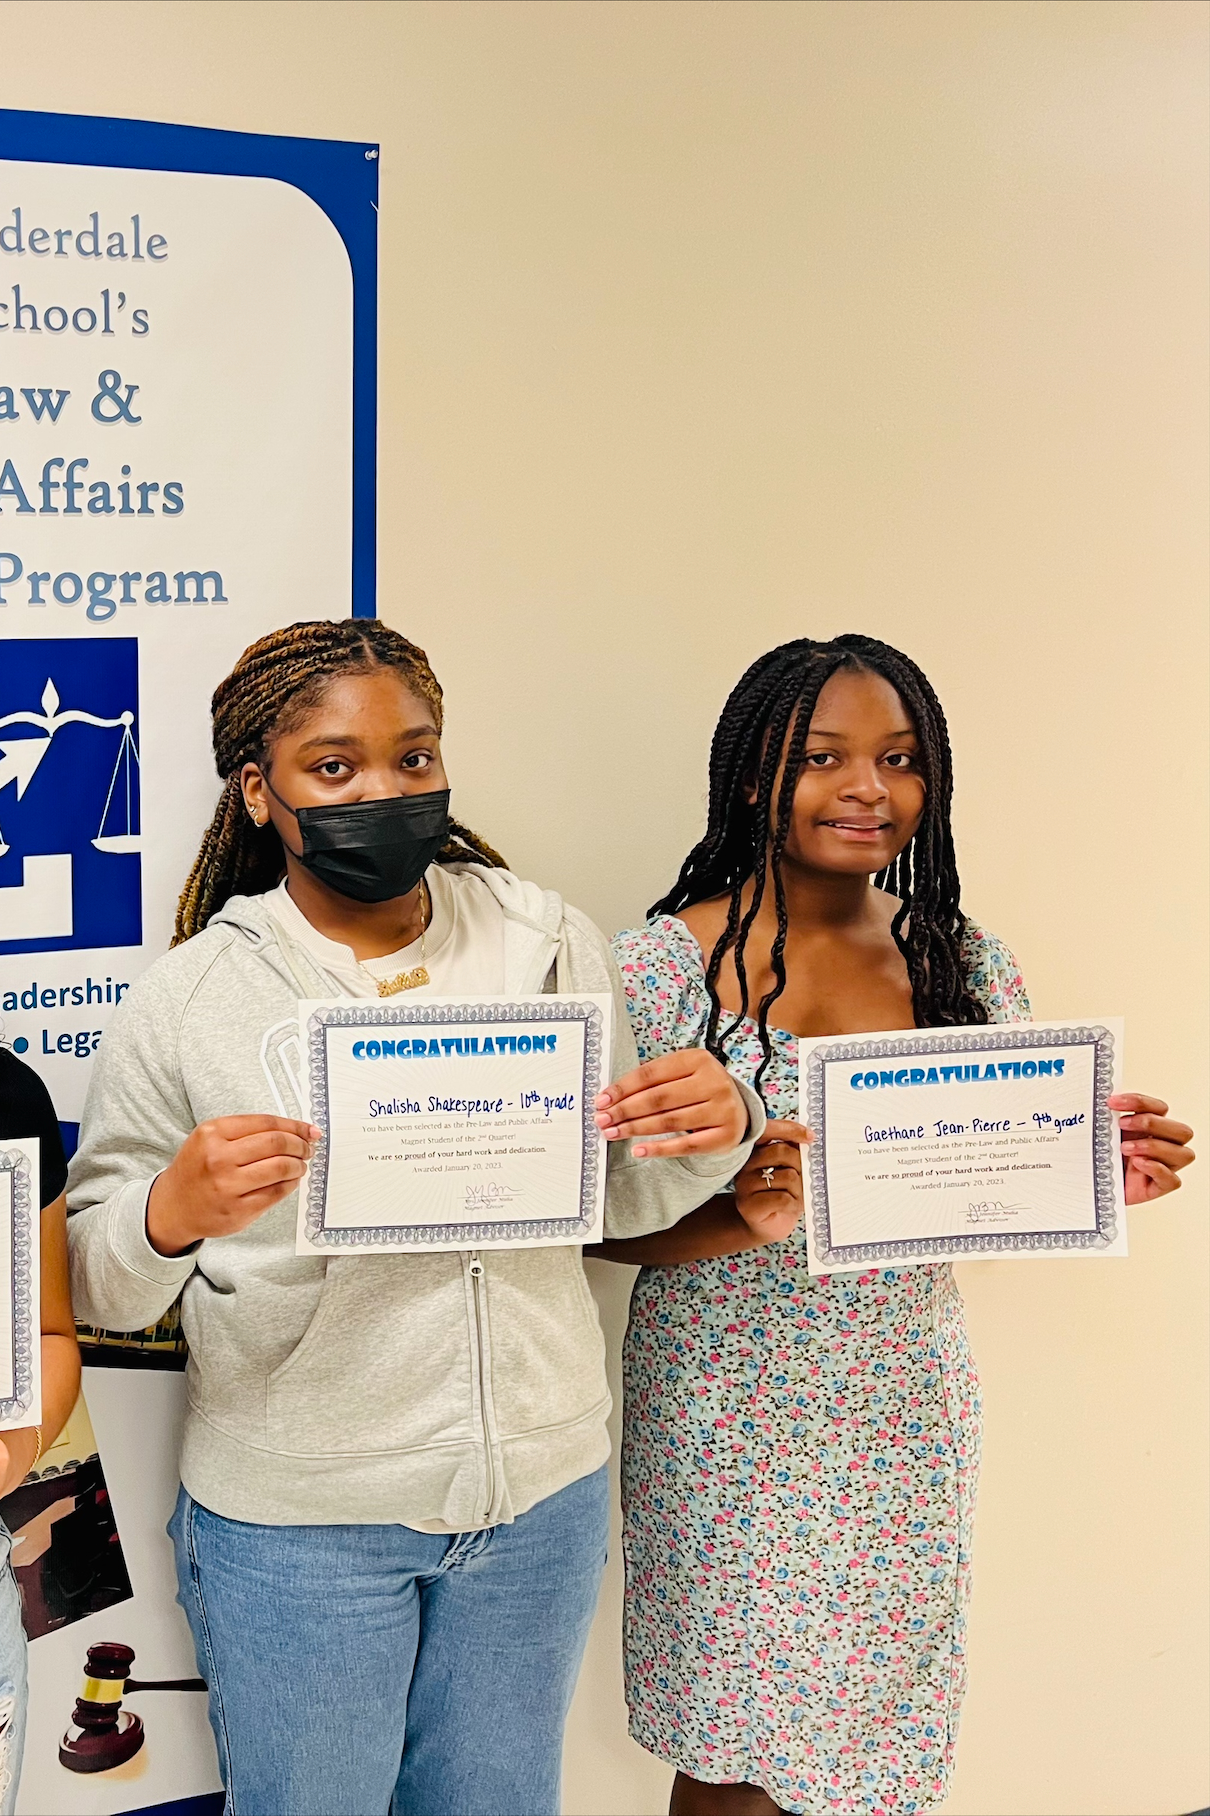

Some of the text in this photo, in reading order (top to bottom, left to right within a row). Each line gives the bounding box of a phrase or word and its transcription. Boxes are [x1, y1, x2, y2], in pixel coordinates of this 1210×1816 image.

[90, 369, 143, 425] &
[42, 1029, 103, 1058] Lega
[352, 1034, 557, 1061] CONGRATULATIONS
[850, 1059, 1065, 1091] CONGRATULATIONS
[369, 1098, 421, 1117] Shalisha
[428, 1095, 503, 1117] Shakespeare
[544, 1093, 575, 1116] grade
[413, 1121, 442, 1130] selected
[493, 1118, 506, 1126] and
[507, 1117, 528, 1125] Public
[864, 1124, 924, 1143] Gaethane
[1054, 1113, 1085, 1133] grade
[910, 1142, 939, 1150] selected
[994, 1137, 1008, 1145] and
[1009, 1136, 1032, 1144] Public
[1033, 1134, 1059, 1142] Affairs
[403, 1151, 426, 1160] proud
[427, 1150, 435, 1158] of
[924, 1155, 952, 1163] Student
[901, 1170, 923, 1179] proud
[954, 1166, 972, 1174] hard
